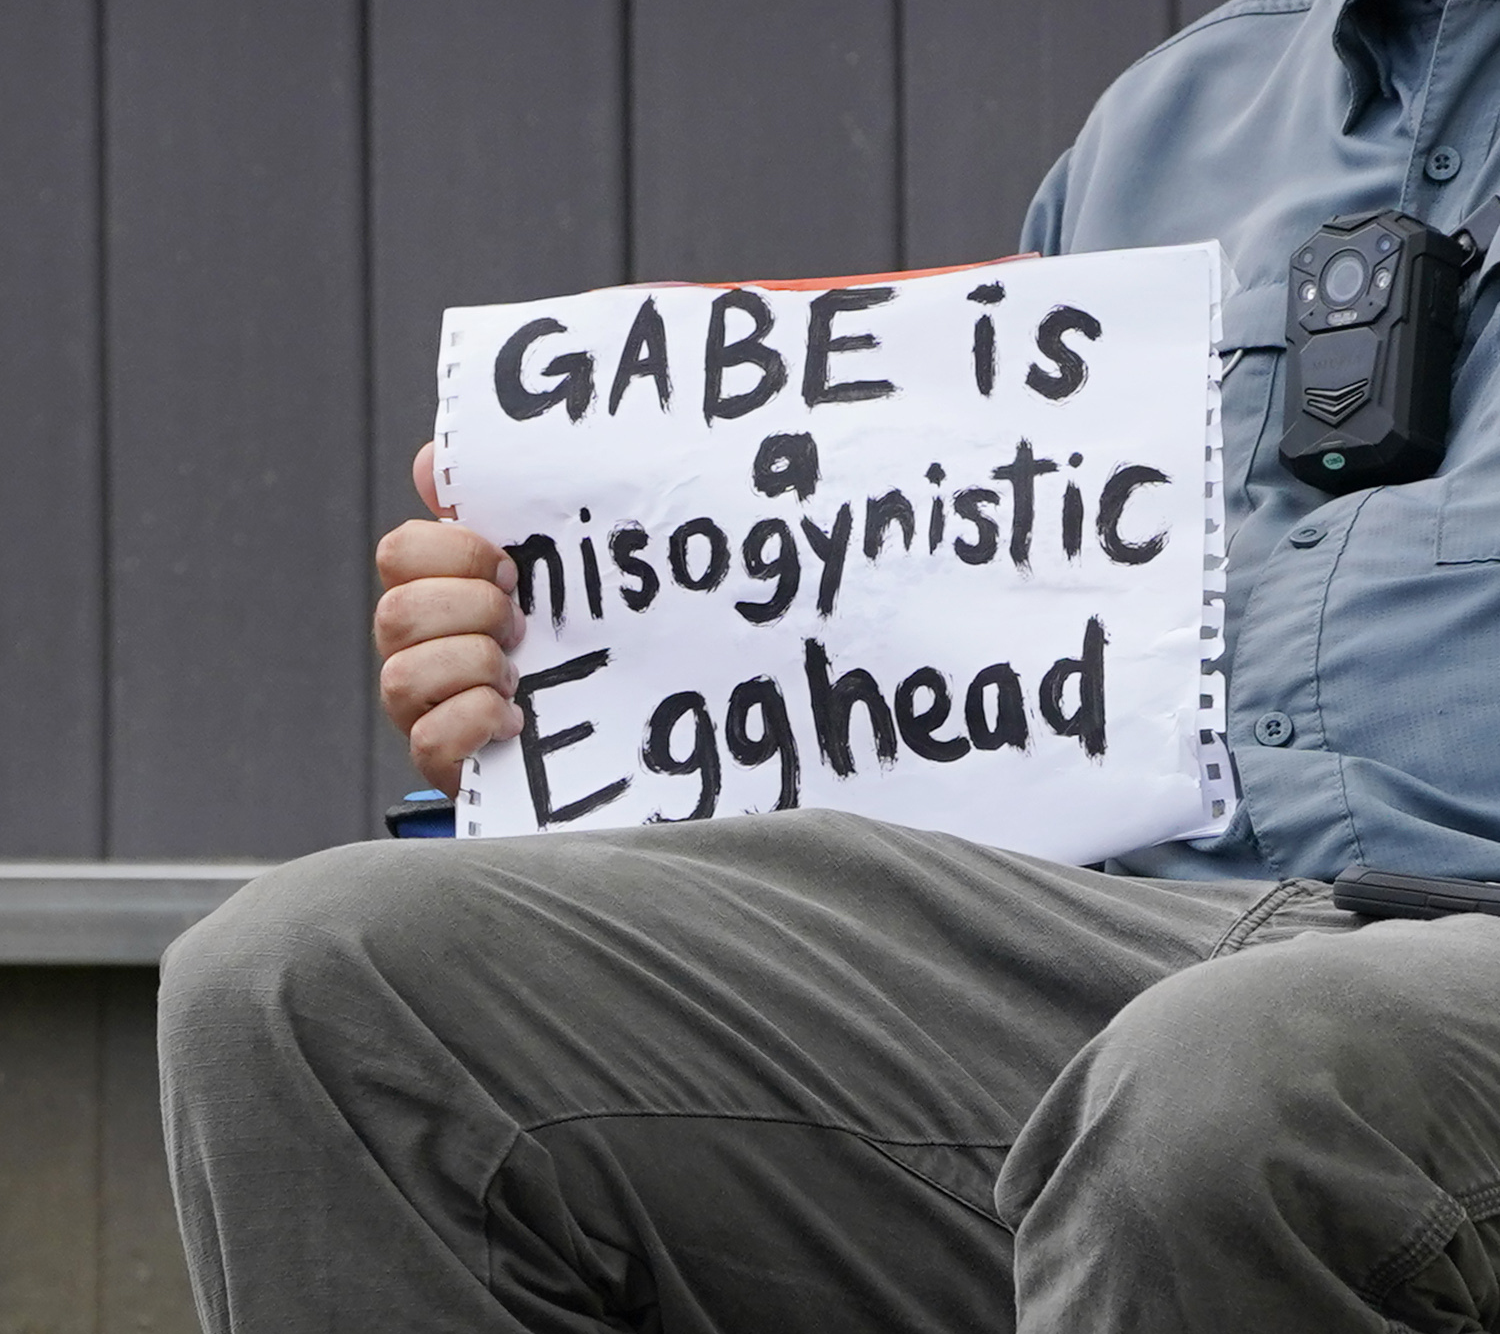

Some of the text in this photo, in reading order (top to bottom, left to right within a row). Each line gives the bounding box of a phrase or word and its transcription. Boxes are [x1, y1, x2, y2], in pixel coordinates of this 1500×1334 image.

[493, 280, 1103, 427] GABE is
[503, 435, 1175, 640] misogynistic
[750, 432, 822, 499] a
[513, 614, 1112, 830] Egghead
